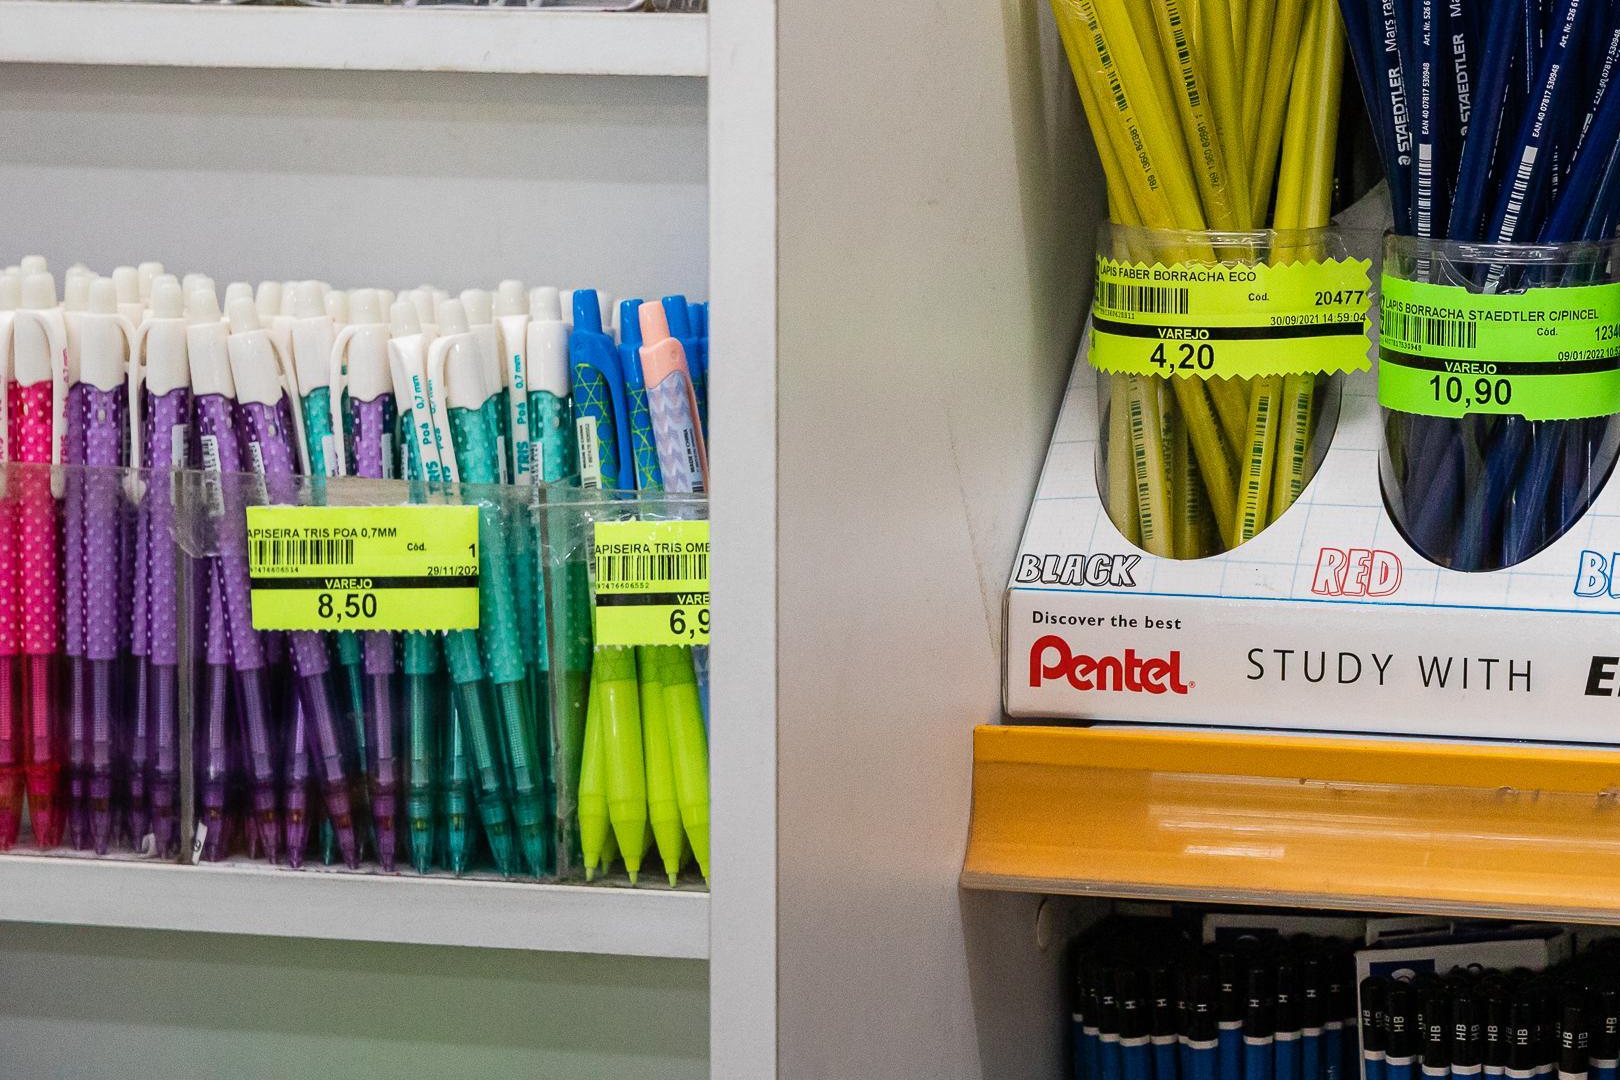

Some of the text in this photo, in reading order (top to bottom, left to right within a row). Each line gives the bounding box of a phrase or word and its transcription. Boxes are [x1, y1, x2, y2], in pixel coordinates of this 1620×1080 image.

[1385, 20, 1398, 53] Mars
[1388, 66, 1410, 153] STAEDTLER
[1119, 267, 1257, 282] FABER BORRACHA ECO
[1314, 290, 1364, 306] 20477
[1270, 312, 1367, 326] 30/09/2021 14:59:04
[1386, 299, 1599, 322] LAPIS BORRACHA STAEDTLER C/PINCEL
[1158, 328, 1210, 340] VAREJO
[1536, 327, 1558, 337] Cód.
[1150, 342, 1215, 374] 4,20
[1558, 349, 1605, 362] 09/01/2022
[1444, 361, 1497, 375] VAREJO
[1429, 374, 1512, 407] 10,90
[304, 528, 330, 538] TRIS
[333, 528, 358, 538] POA
[361, 527, 397, 538] 0,7MM
[654, 543, 681, 554] TRIS
[1016, 553, 1141, 587] BLACK
[1311, 547, 1403, 597] RED
[325, 578, 373, 589] VAREJO
[317, 593, 377, 623] 8,50
[1032, 611, 1182, 630] Discover the best
[1029, 634, 1189, 695] Pentel
[1246, 648, 1532, 692] STUDY WITH
